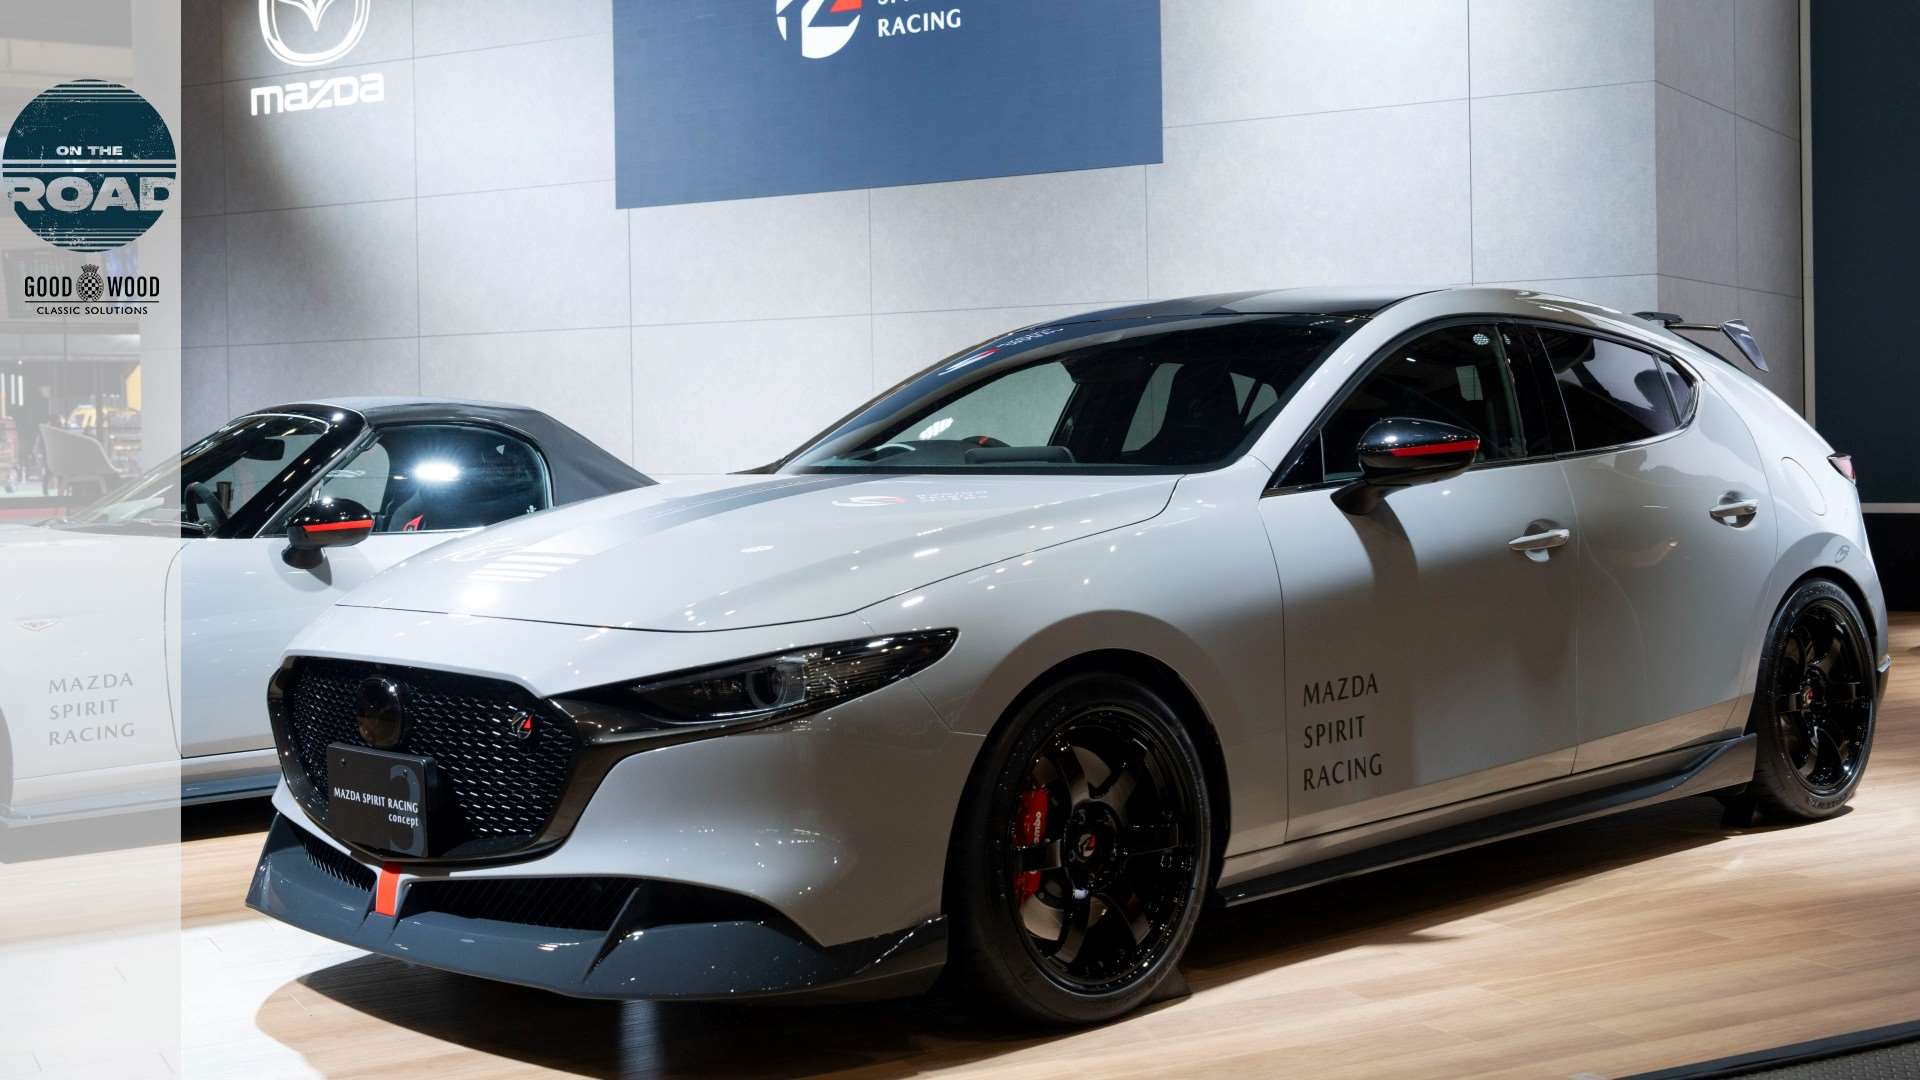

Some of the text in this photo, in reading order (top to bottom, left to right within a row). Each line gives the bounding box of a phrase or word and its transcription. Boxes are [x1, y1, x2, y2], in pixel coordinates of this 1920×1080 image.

[878, 9, 961, 37] RACING
[48, 672, 133, 694] MAZDA
[1303, 672, 1379, 708] MAZDA
[49, 698, 119, 720] SPIRIT
[48, 722, 136, 746] RACING
[1303, 715, 1366, 749] SPIRIT
[1303, 753, 1383, 791] RACING
[334, 787, 418, 813] MAZDA SPIRIT RACING
[388, 814, 419, 828] concept
